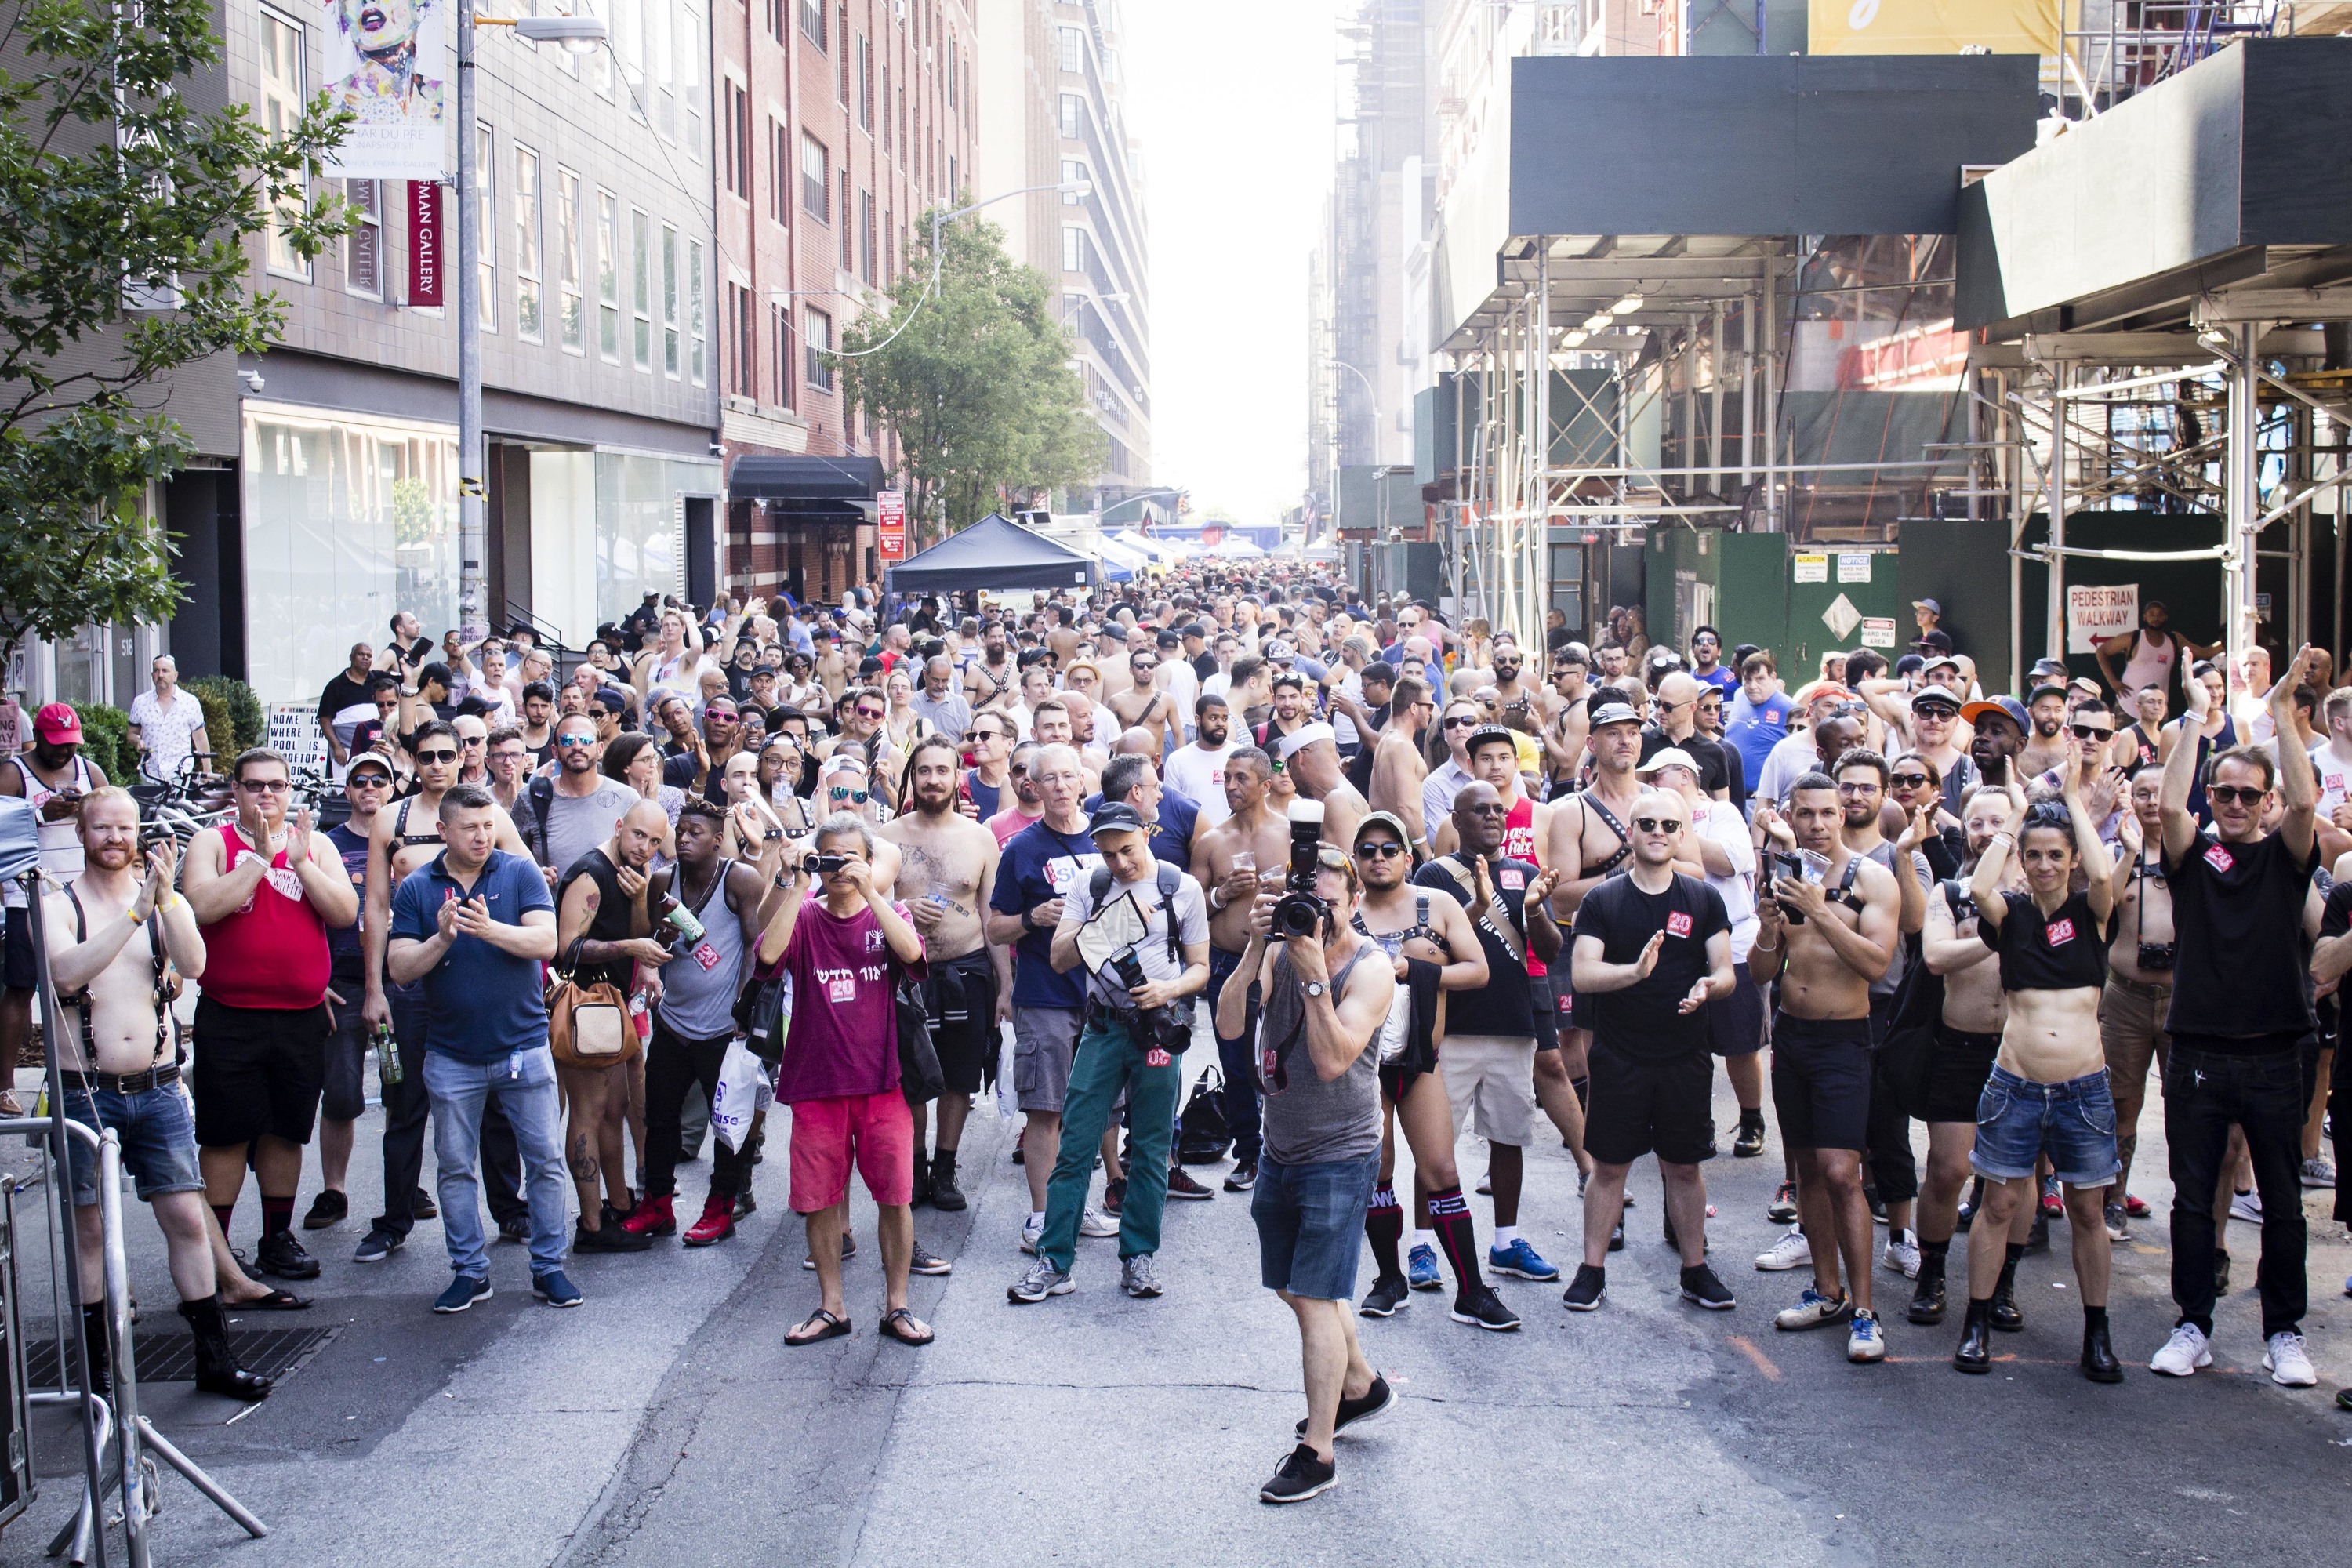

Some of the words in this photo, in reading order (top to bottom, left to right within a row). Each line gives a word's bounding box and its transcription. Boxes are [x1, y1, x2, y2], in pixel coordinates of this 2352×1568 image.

[380, 129, 399, 140] DU
[403, 129, 426, 140] PRE
[353, 141, 407, 151] SNAPSHOTS
[419, 228, 434, 295] GALLERY
[2072, 590, 2134, 607] PEDESTRIAN
[2077, 610, 2129, 626] WALKWAY
[122, 638, 133, 657] 518
[273, 714, 299, 724] HOME
[310, 715, 320, 725] IS
[1766, 710, 1779, 720] 20
[270, 727, 302, 738] WHERE
[273, 740, 296, 750] POOL
[2326, 776, 2343, 788] 20
[1508, 840, 1534, 855] face.
[2209, 846, 2233, 868] 20
[1501, 870, 1523, 885] 20
[1669, 913, 1691, 932] 20
[2048, 920, 2073, 942] 20
[696, 946, 719, 967] 20
[831, 981, 855, 996] 20
